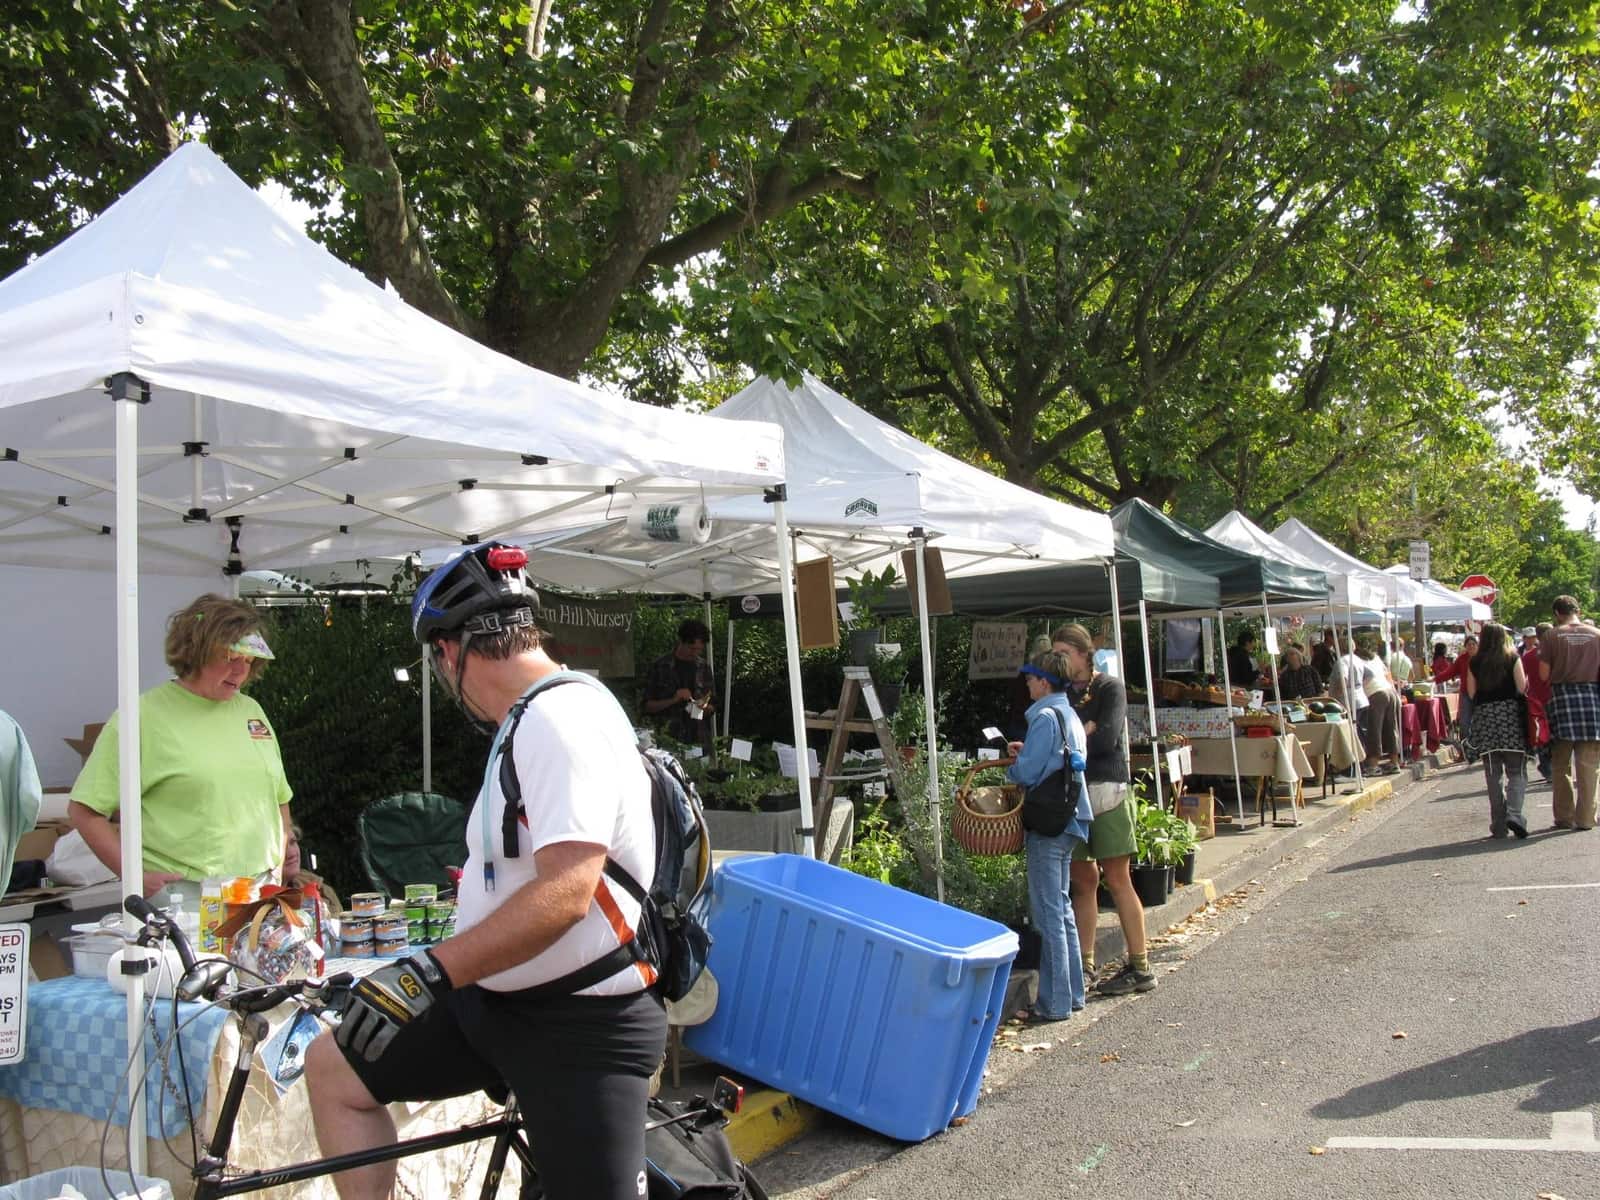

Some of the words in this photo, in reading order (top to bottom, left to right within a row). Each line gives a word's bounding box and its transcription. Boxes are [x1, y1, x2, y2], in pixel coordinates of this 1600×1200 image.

[845, 498, 877, 517] CARAVAN
[560, 604, 584, 626] Hill
[585, 608, 633, 632] Nursery
